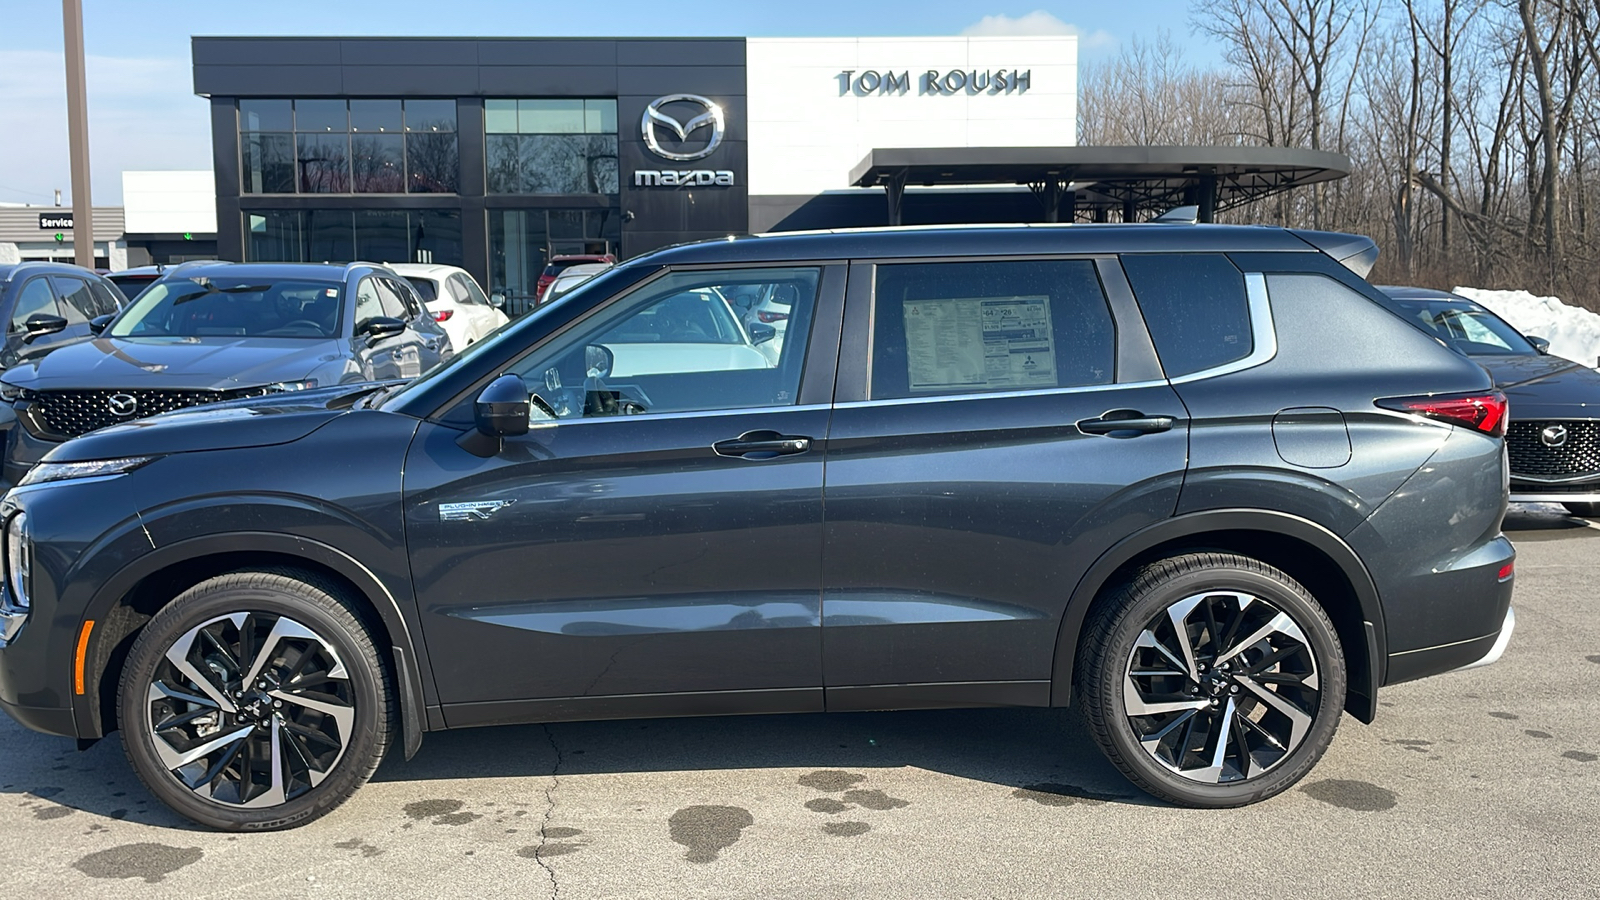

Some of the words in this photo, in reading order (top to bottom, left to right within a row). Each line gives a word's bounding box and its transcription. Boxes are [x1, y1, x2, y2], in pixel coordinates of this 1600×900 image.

[841, 70, 911, 91] TOM
[926, 69, 1031, 91] ROUSH
[41, 218, 73, 228] Service
[1103, 622, 1131, 718] BRIDGESTONE
